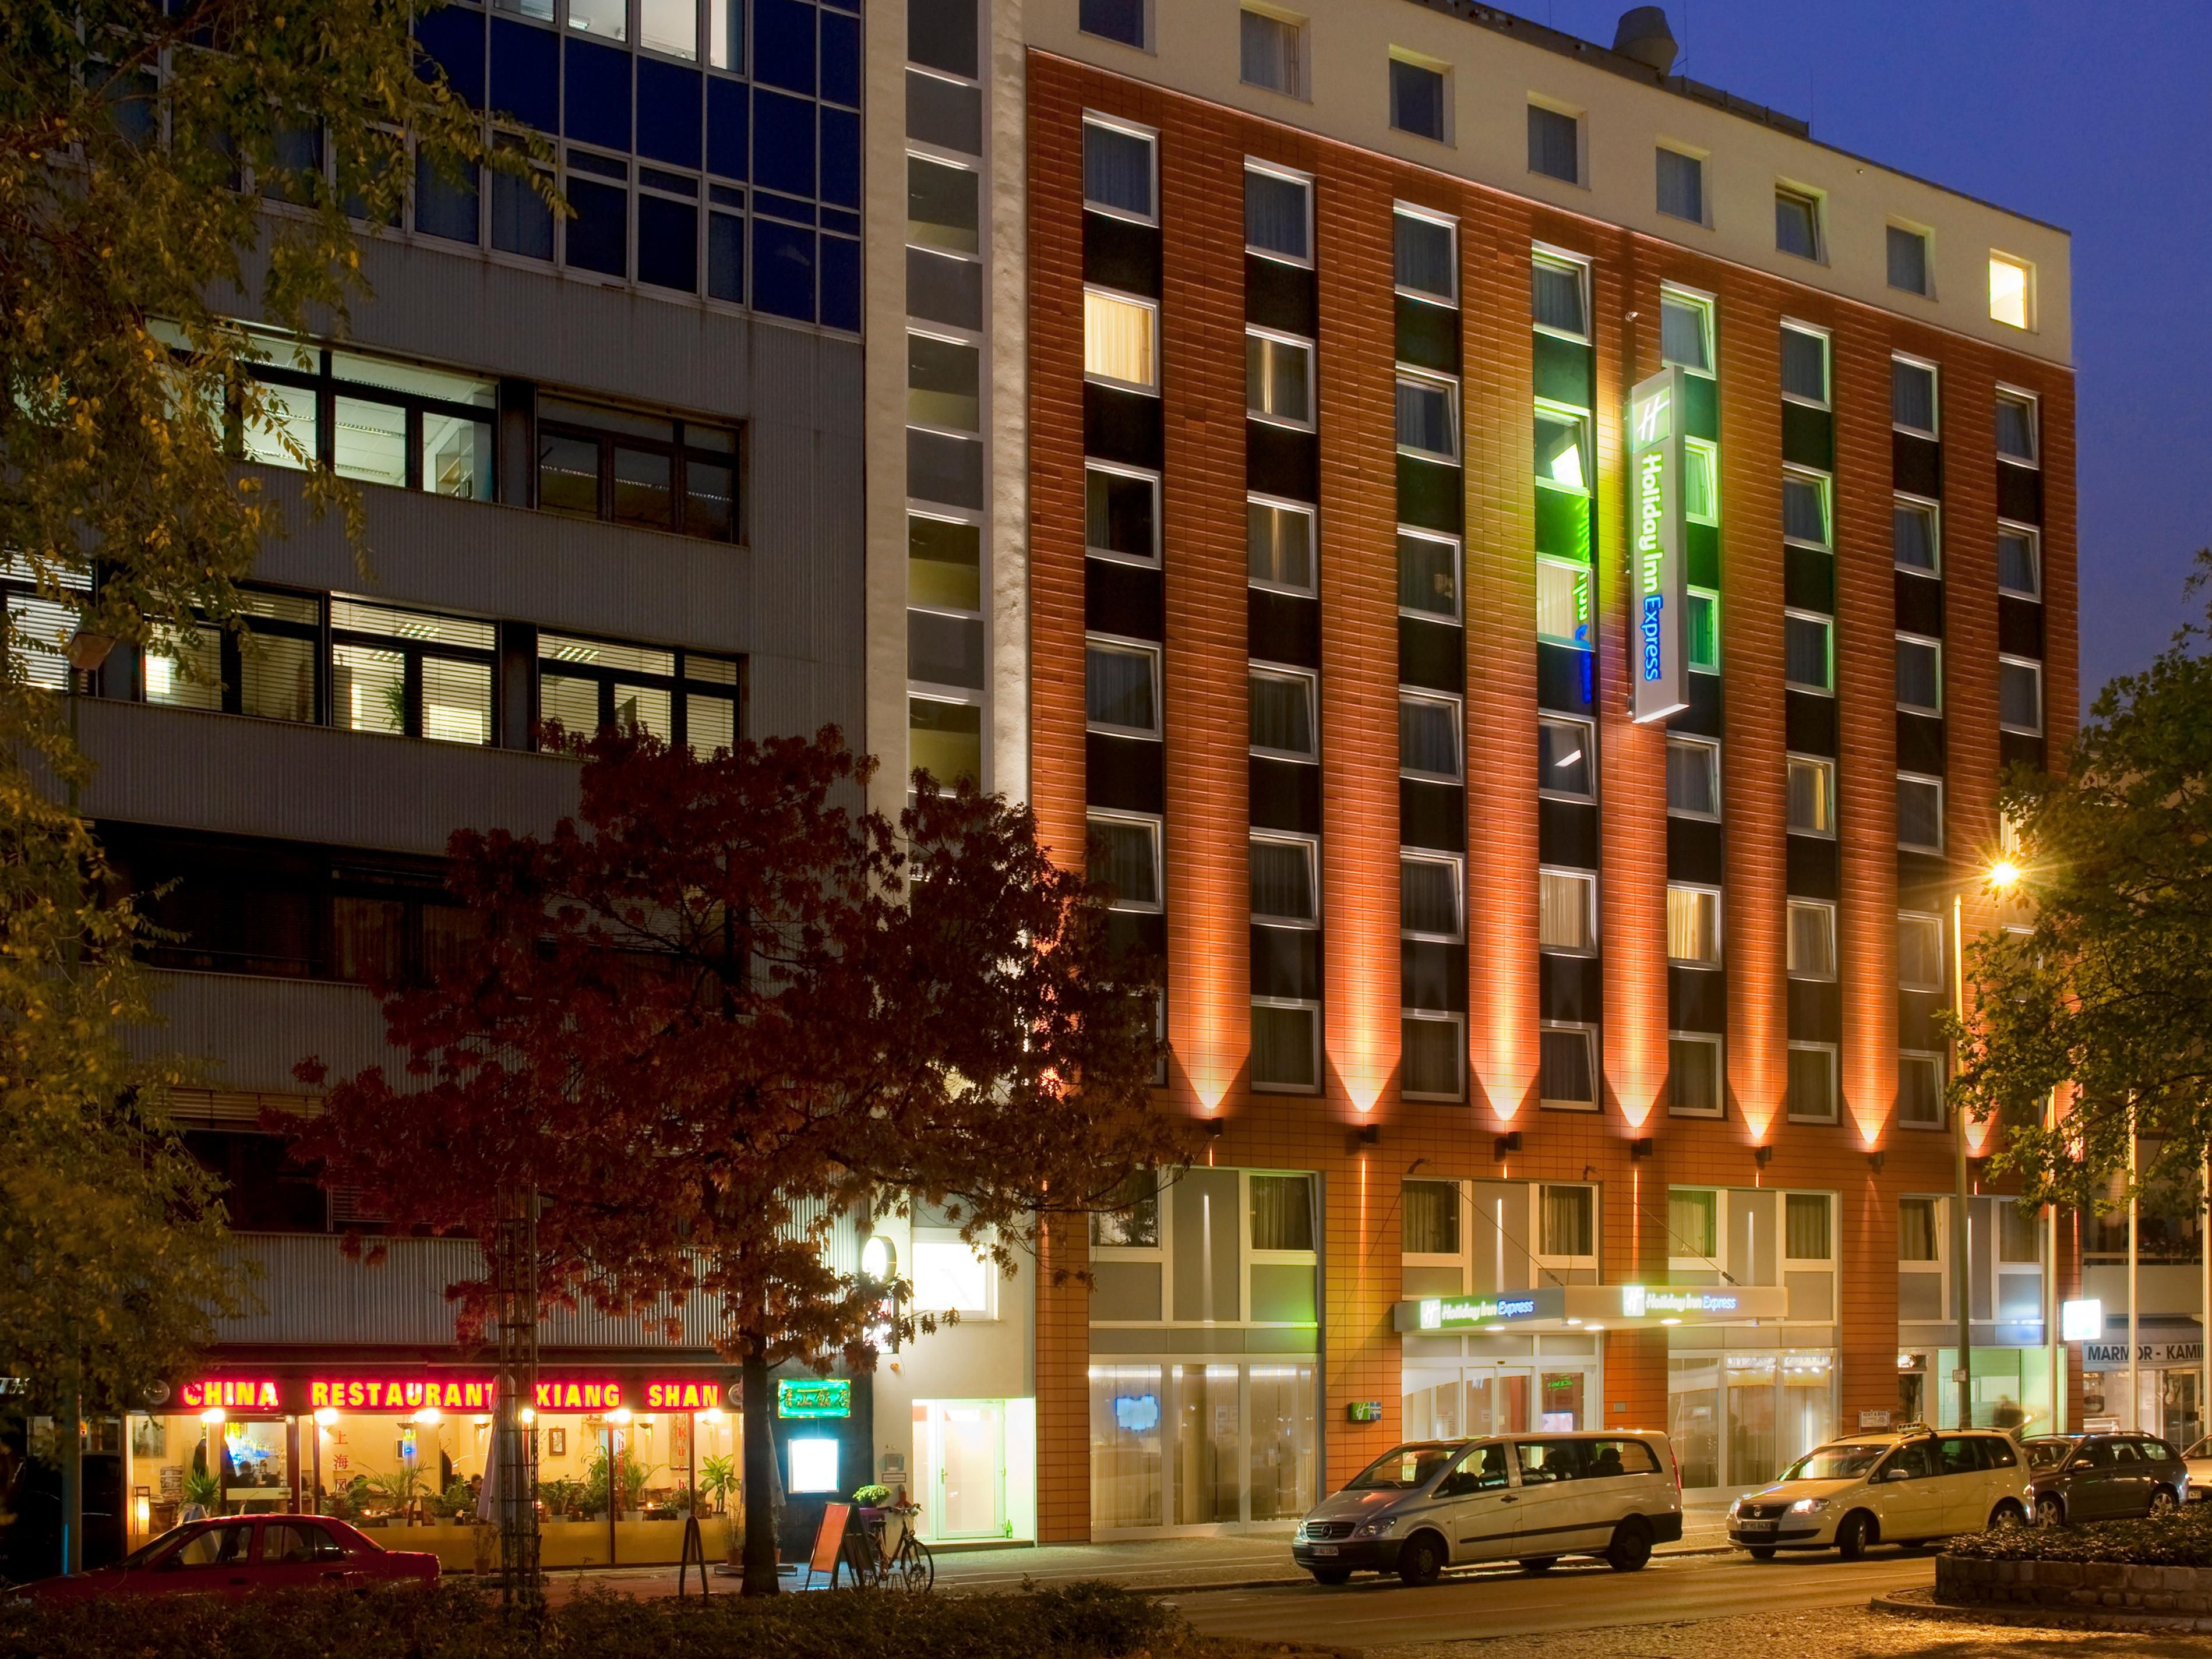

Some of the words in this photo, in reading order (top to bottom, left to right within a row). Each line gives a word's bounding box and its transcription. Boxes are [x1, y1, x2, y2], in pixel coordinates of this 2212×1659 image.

[1639, 454, 1662, 549] Holiday
[1642, 549, 1663, 594] Inn
[1641, 595, 1662, 681] Express
[1442, 1302, 1480, 1321] Holiday
[1480, 1300, 1497, 1316] Inn
[1498, 1300, 1534, 1317] Express
[1646, 1293, 1685, 1312] Holiday
[1686, 1293, 1702, 1309] Inn
[1703, 1296, 1736, 1311] Express
[2167, 1344, 2204, 1360] KAMI
[184, 1381, 279, 1407] CHINA
[535, 1383, 620, 1407] XIANG
[648, 1384, 718, 1407] SHAN
